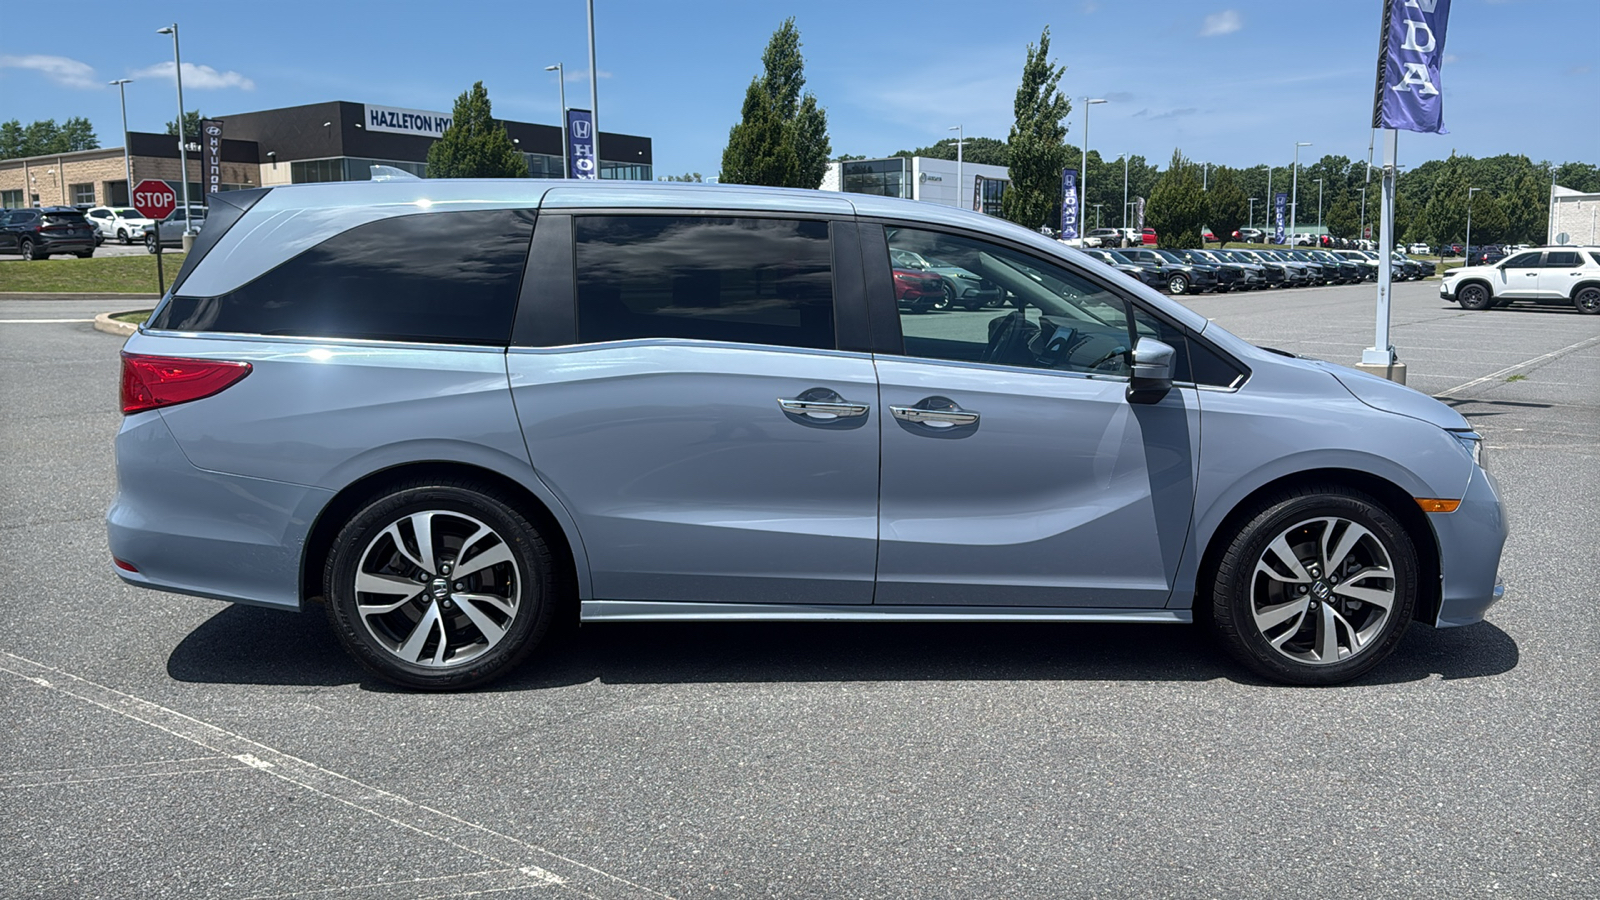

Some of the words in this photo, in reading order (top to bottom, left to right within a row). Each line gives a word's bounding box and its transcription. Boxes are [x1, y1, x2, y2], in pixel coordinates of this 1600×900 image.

[370, 109, 432, 131] HAZLETON
[135, 192, 173, 208] STOP
[1064, 188, 1077, 233] HONDA
